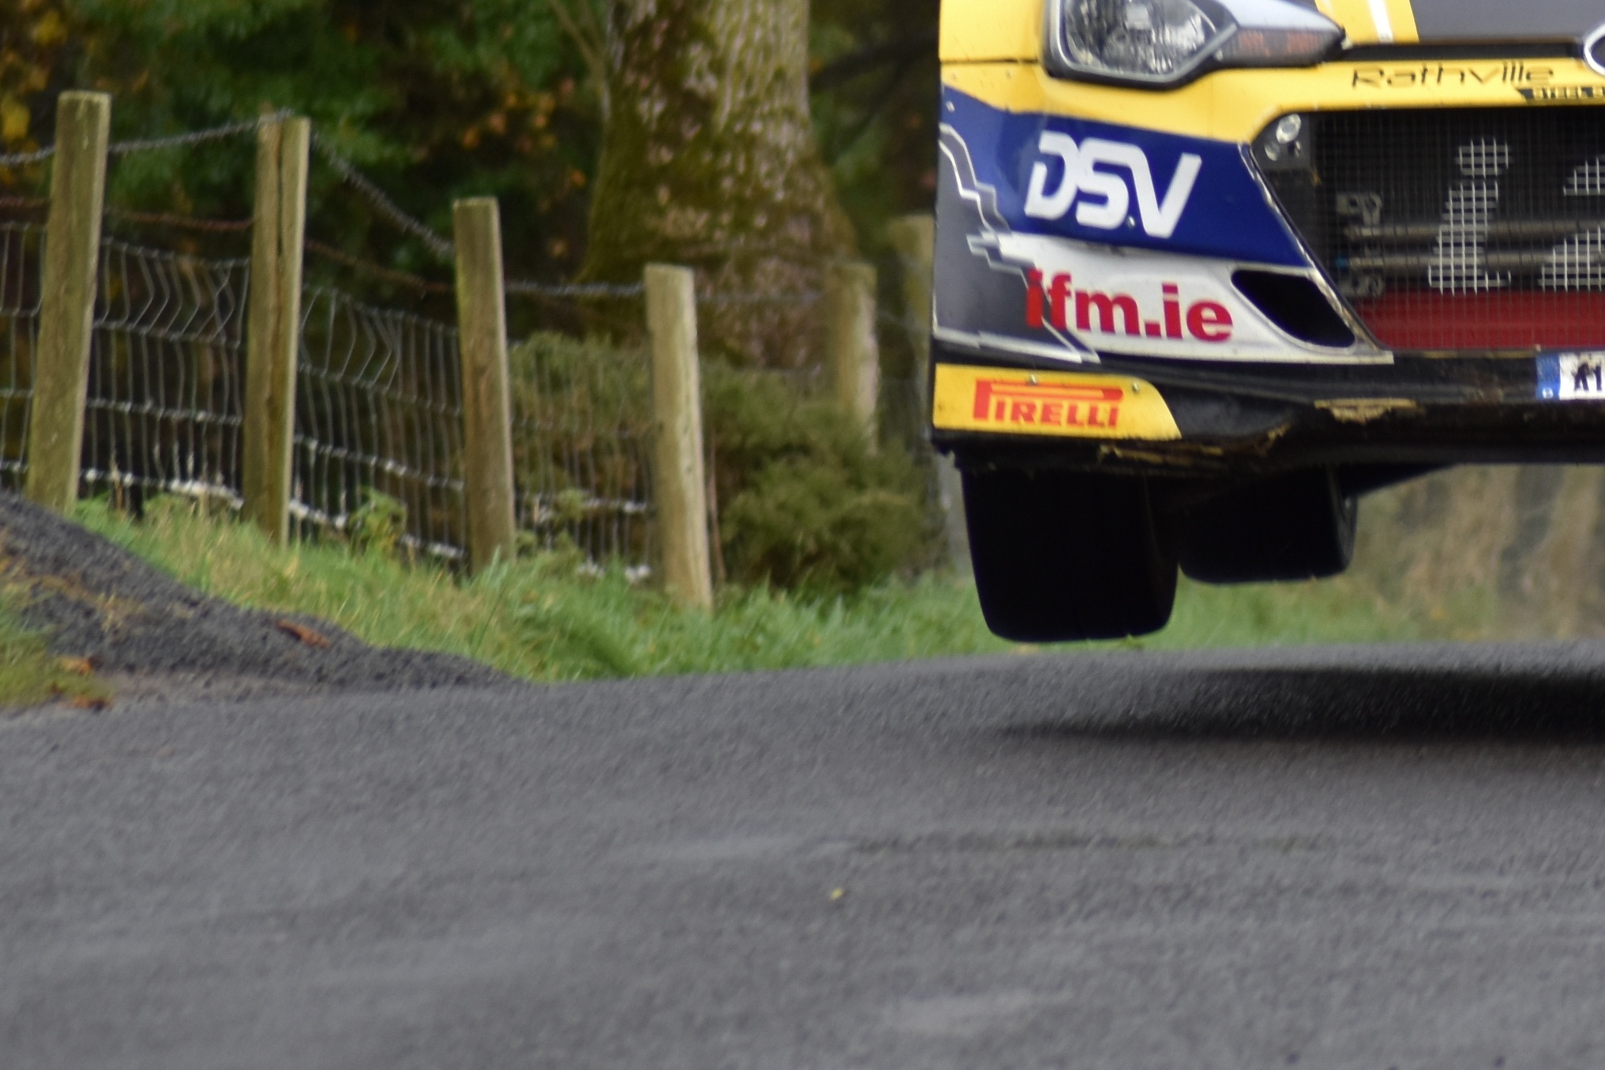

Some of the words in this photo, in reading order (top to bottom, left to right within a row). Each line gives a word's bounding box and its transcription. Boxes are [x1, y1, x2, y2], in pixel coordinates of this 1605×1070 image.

[1350, 59, 1555, 88] Rathville
[1024, 129, 1203, 239] DSV
[1025, 267, 1233, 343] ifm.ie
[972, 378, 1124, 429] PIRELLI
